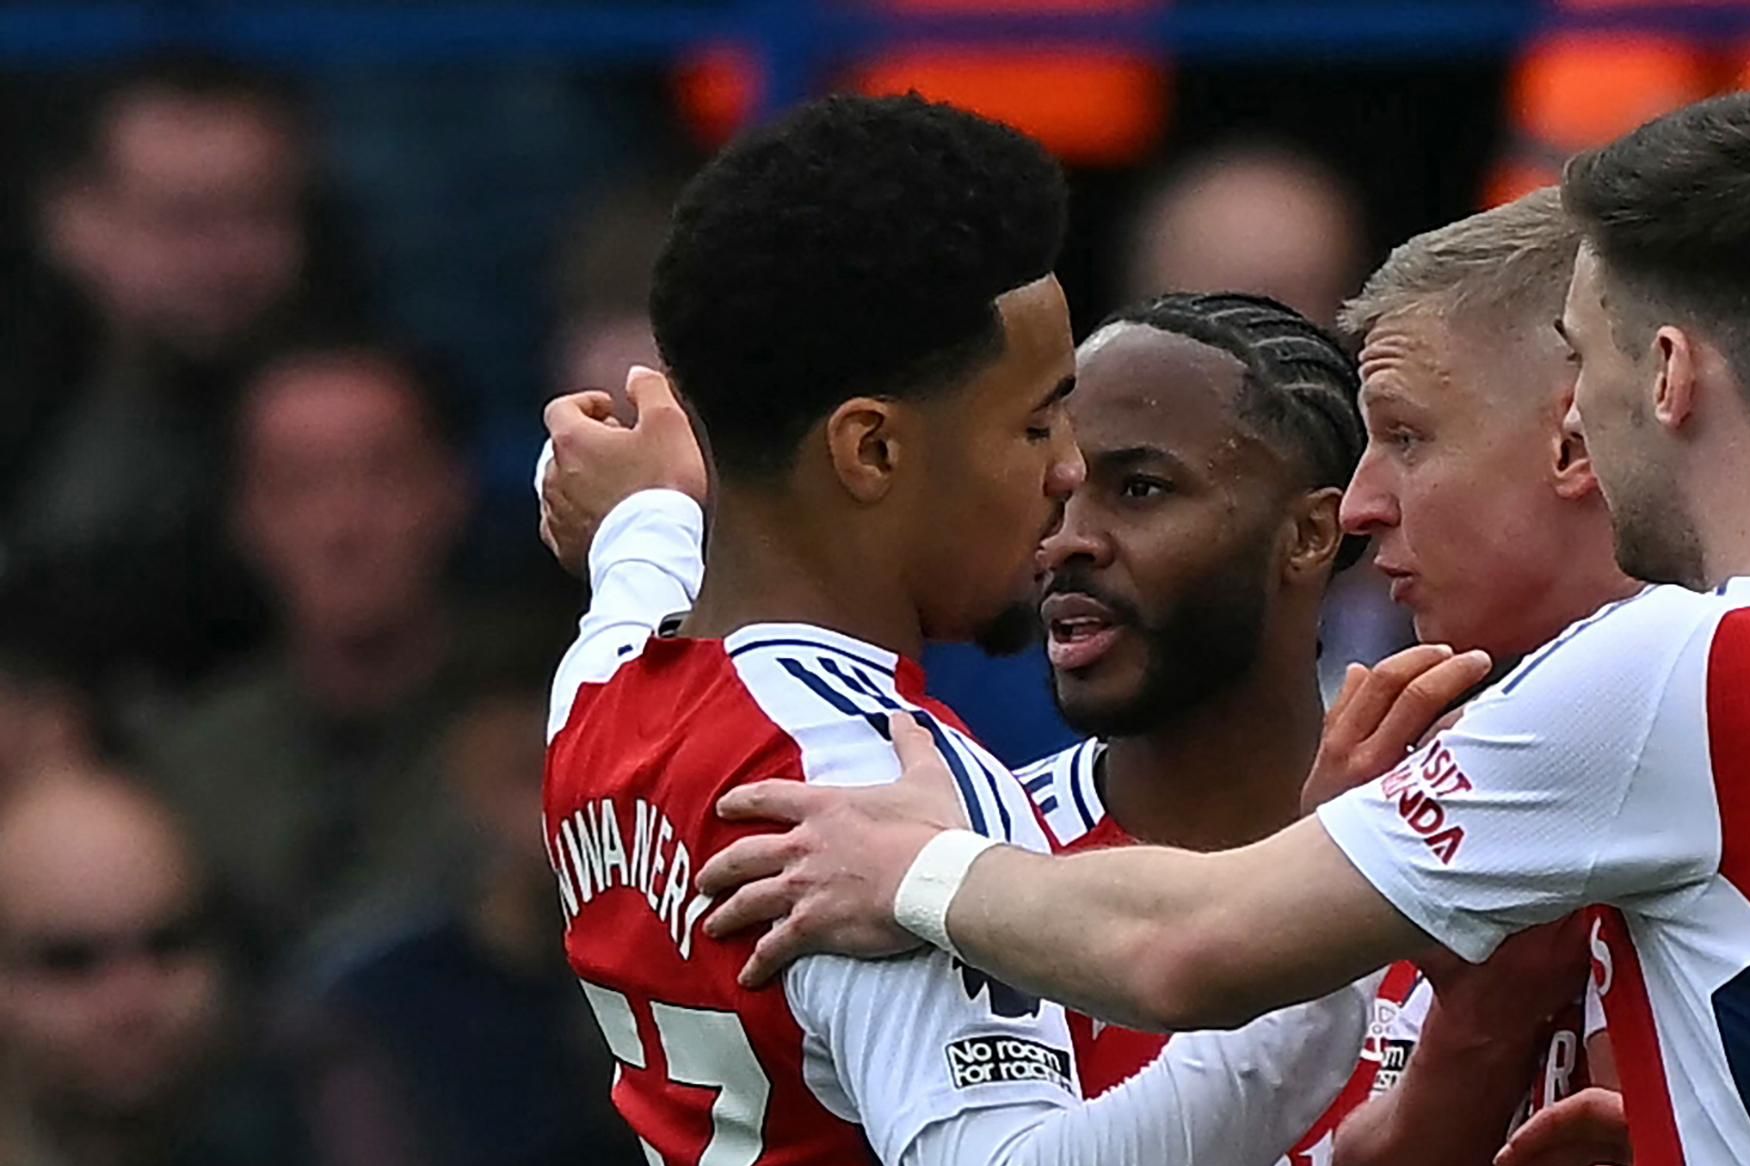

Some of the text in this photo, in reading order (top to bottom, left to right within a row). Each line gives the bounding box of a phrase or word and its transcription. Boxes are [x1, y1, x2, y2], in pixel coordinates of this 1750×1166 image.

[1418, 739, 1473, 798] ISIT
[949, 1041, 1062, 1071] No room
